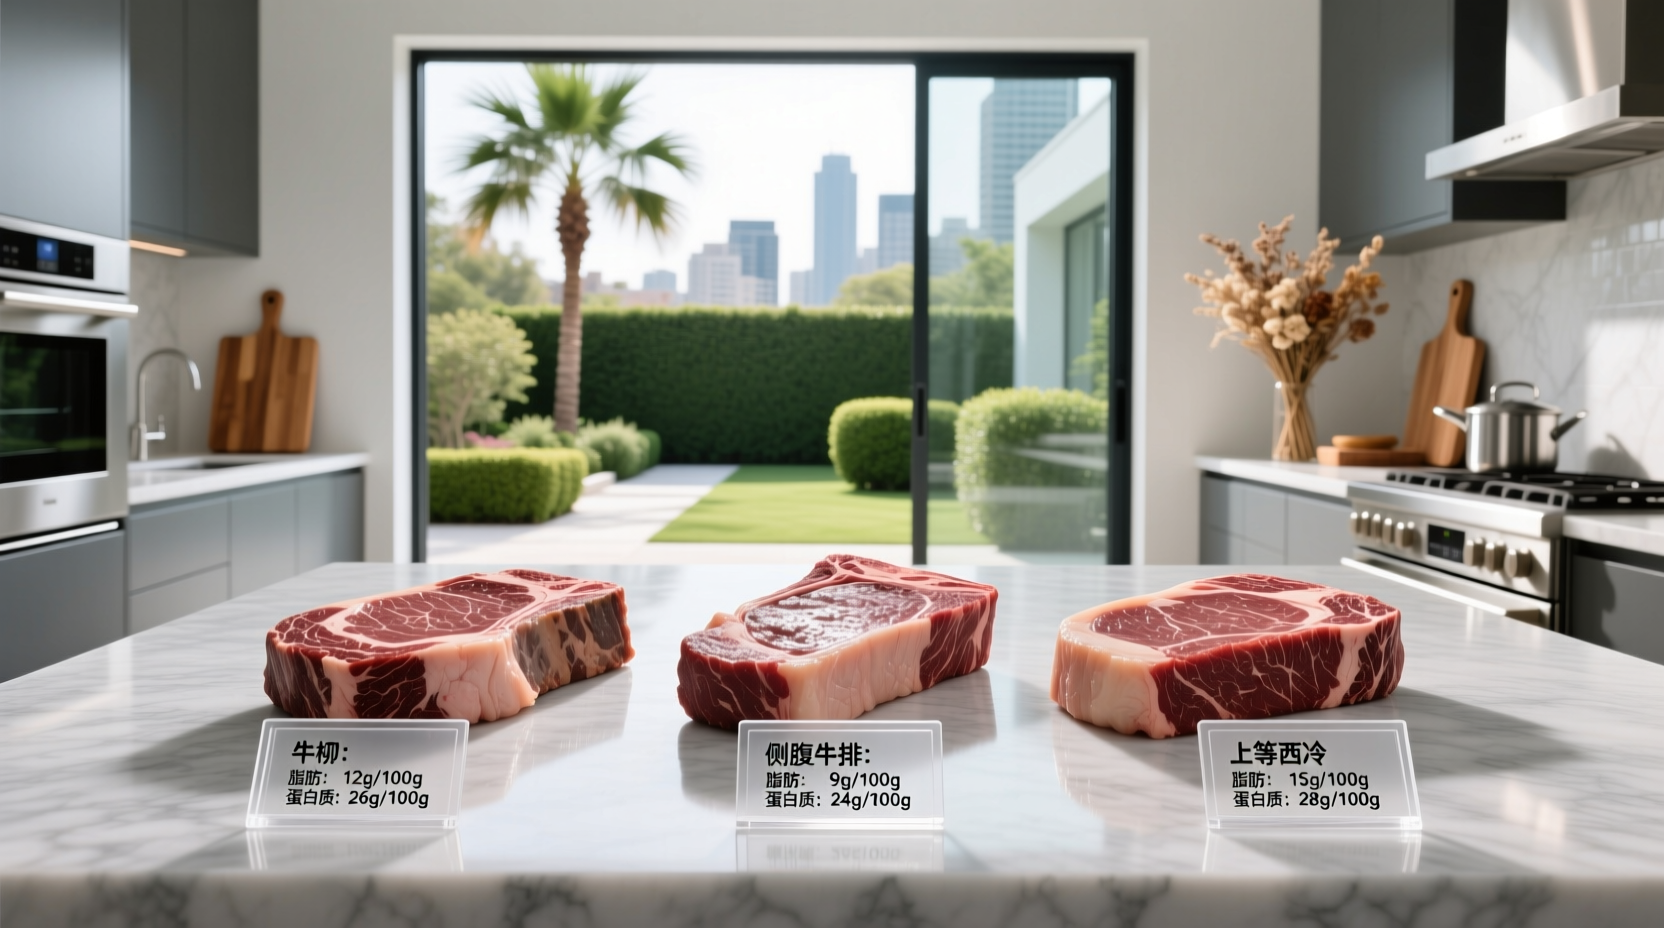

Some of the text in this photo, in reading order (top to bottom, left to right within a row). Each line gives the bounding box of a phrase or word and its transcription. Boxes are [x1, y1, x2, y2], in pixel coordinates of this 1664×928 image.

[1229, 739, 1327, 767] 上等西冷
[343, 769, 423, 790] 12g/100g
[829, 771, 901, 792] 9g/100g
[347, 790, 429, 809] 26g/100g
[830, 790, 911, 811] 24g/100g
[1298, 790, 1380, 811] 28g/100g
